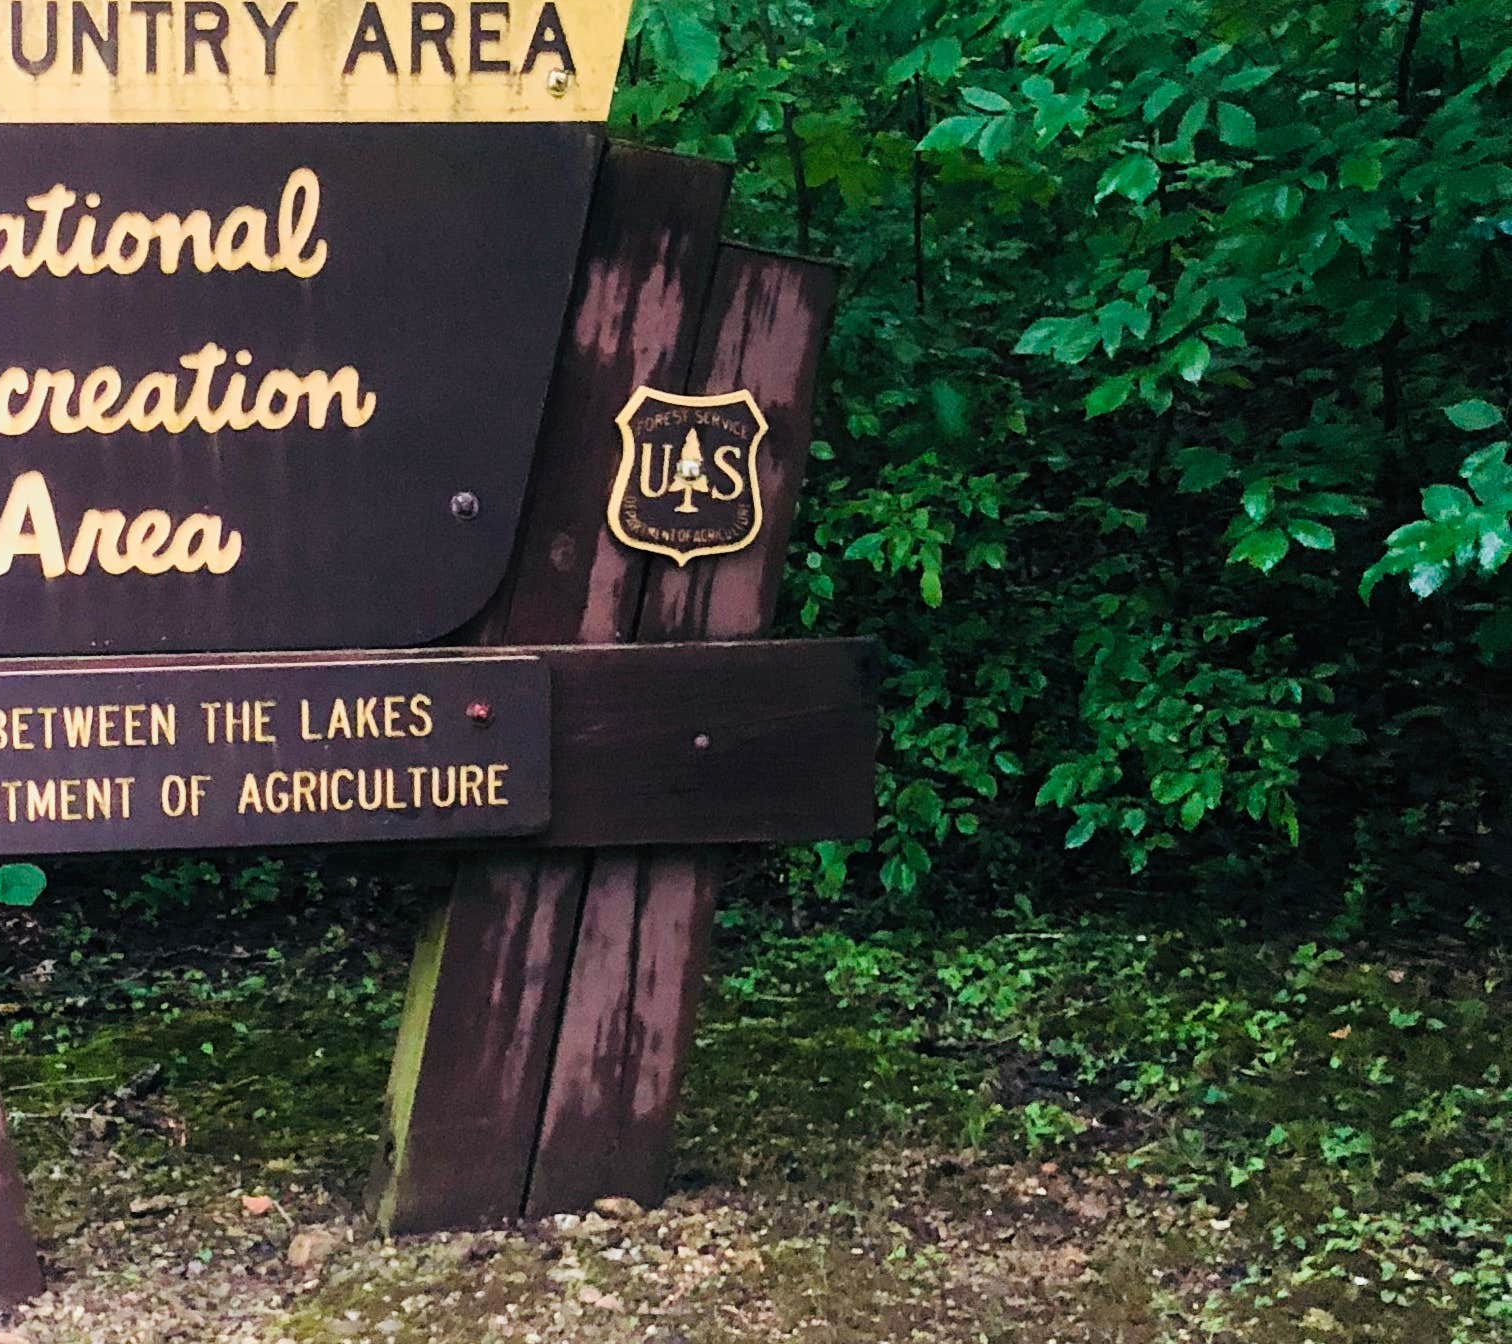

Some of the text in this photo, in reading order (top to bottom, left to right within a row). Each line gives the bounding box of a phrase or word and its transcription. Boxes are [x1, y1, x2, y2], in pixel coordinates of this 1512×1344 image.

[342, 0, 577, 78] AREA
[201, 700, 276, 745] THE
[300, 694, 433, 741] LAKES
[161, 774, 212, 817] OF
[237, 763, 510, 816] AGRICULTURE
